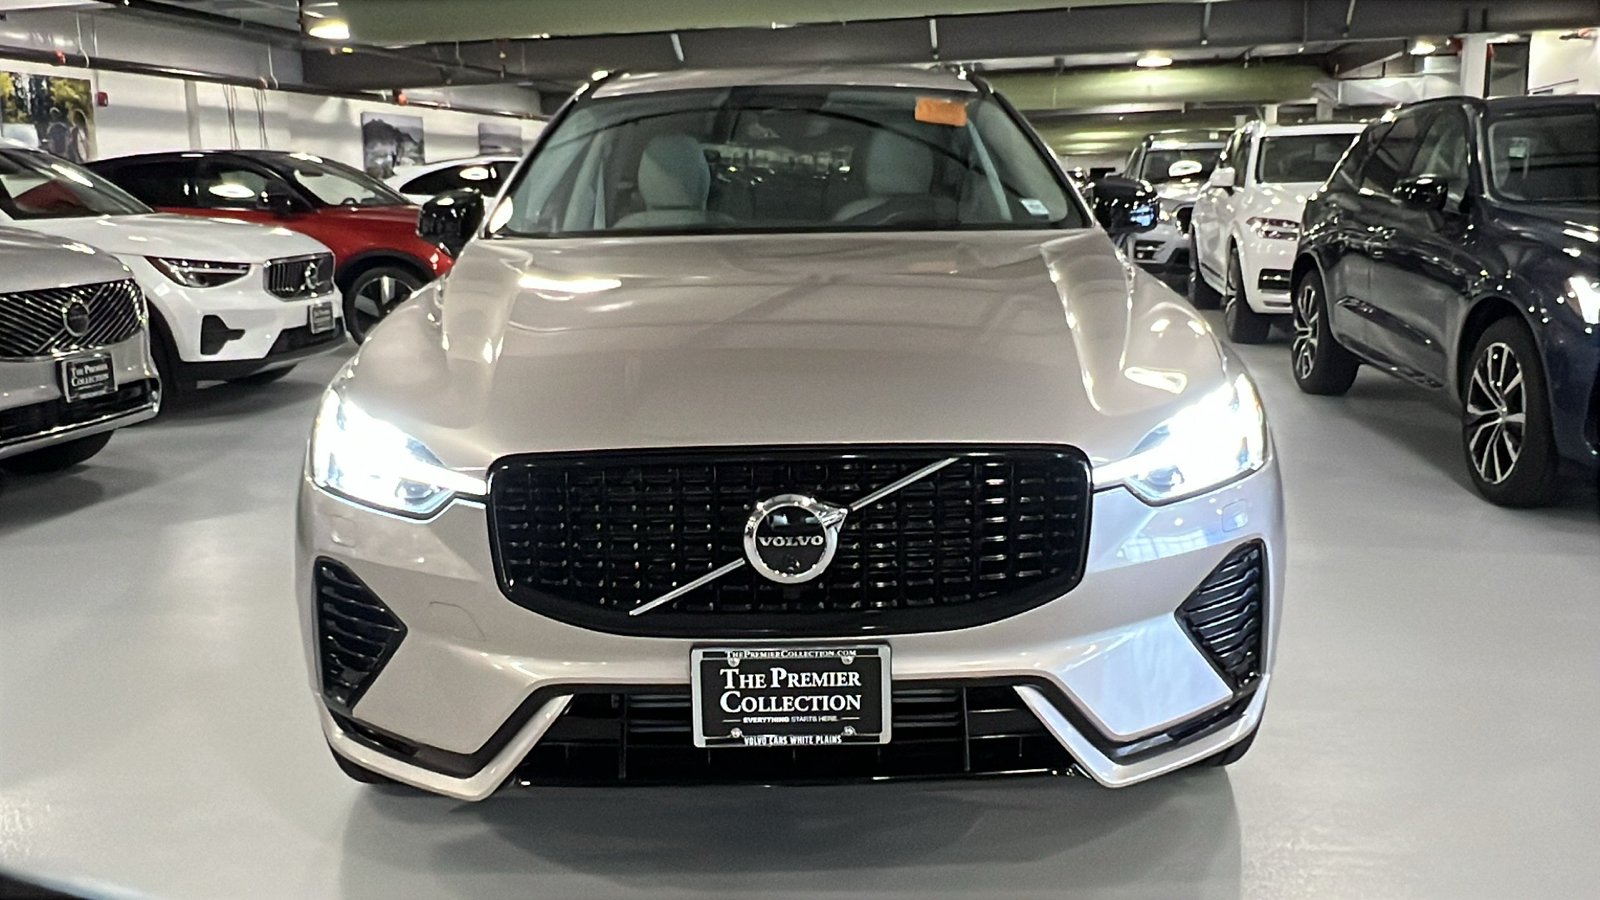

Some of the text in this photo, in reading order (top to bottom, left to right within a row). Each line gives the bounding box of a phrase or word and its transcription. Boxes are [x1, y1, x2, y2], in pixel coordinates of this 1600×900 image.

[757, 535, 824, 547] VOLVO
[719, 667, 862, 689] THE PREMIER
[719, 690, 862, 713] COLLECTION
[742, 716, 790, 724] EVERYTHING
[791, 715, 818, 723] STARTS
[744, 734, 842, 746] VOLVO CARS WHITE PLAINS
